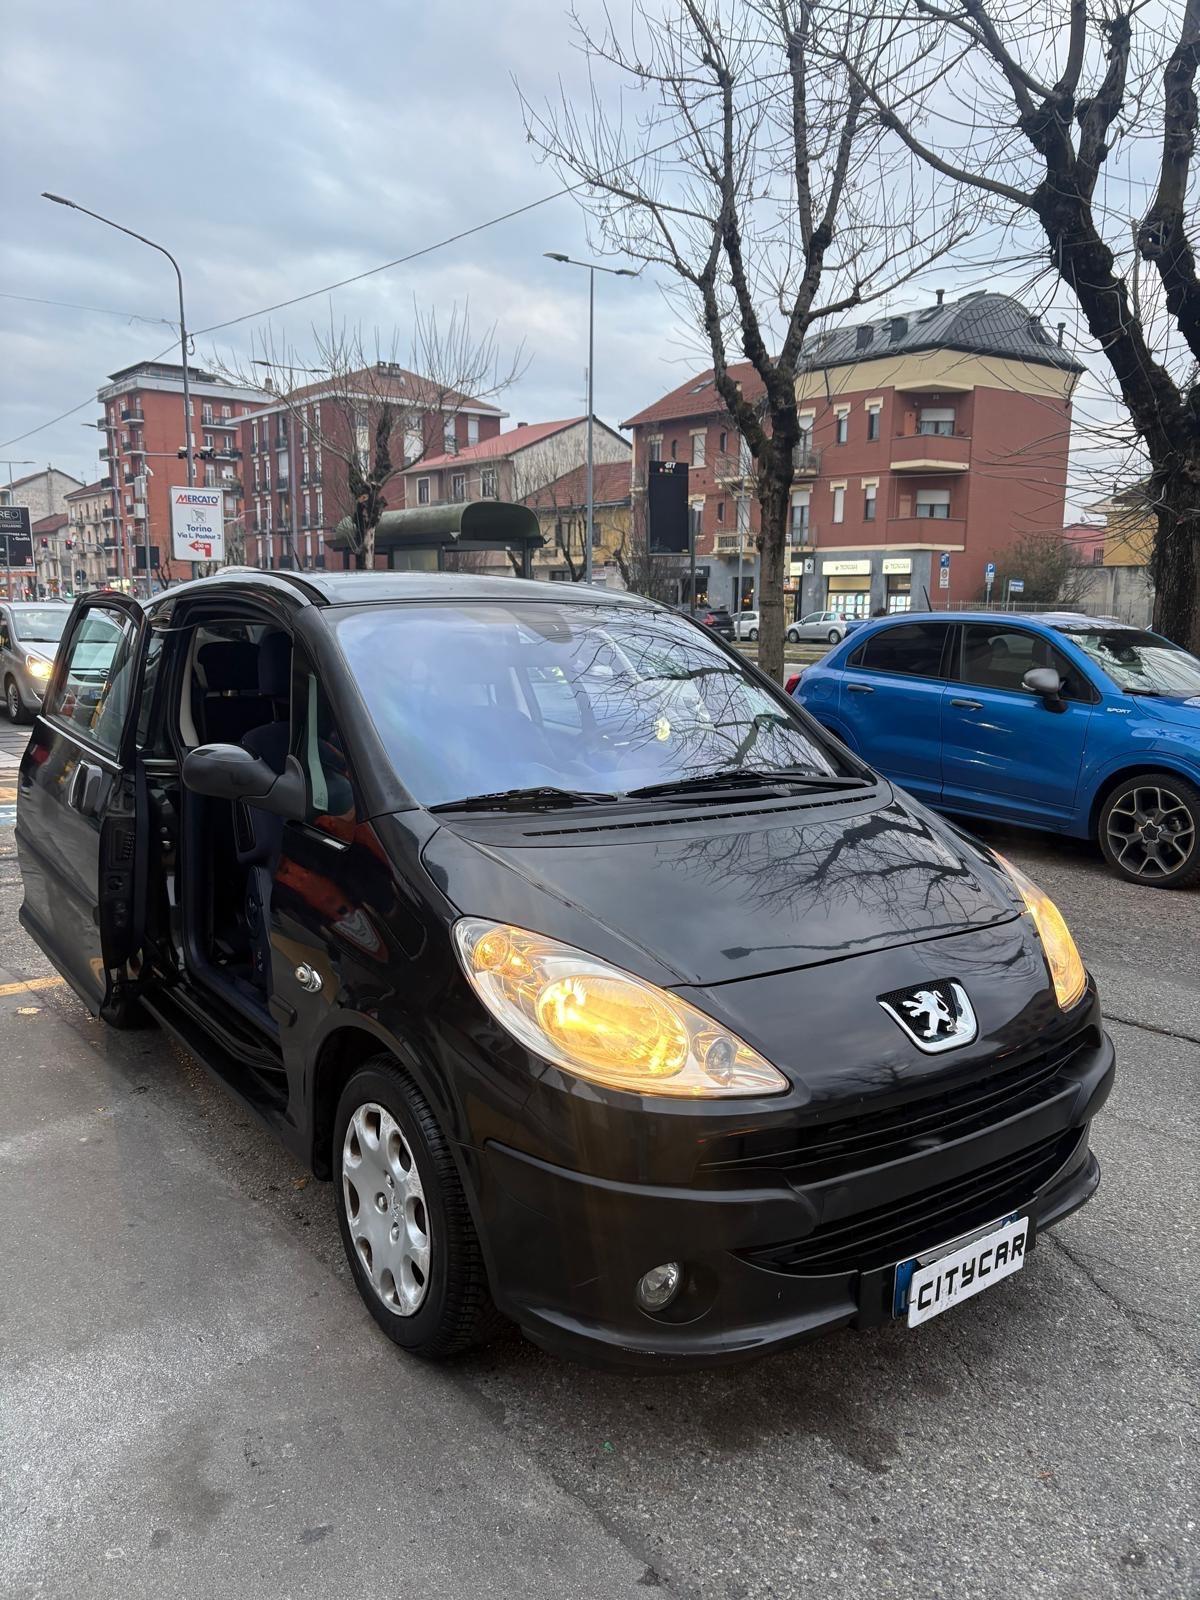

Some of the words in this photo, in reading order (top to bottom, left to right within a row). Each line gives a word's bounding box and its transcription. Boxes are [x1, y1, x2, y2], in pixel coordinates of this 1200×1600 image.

[187, 524, 212, 533] Torino
[987, 563, 994, 573] P
[917, 1232, 1026, 1312] CITYCAR
